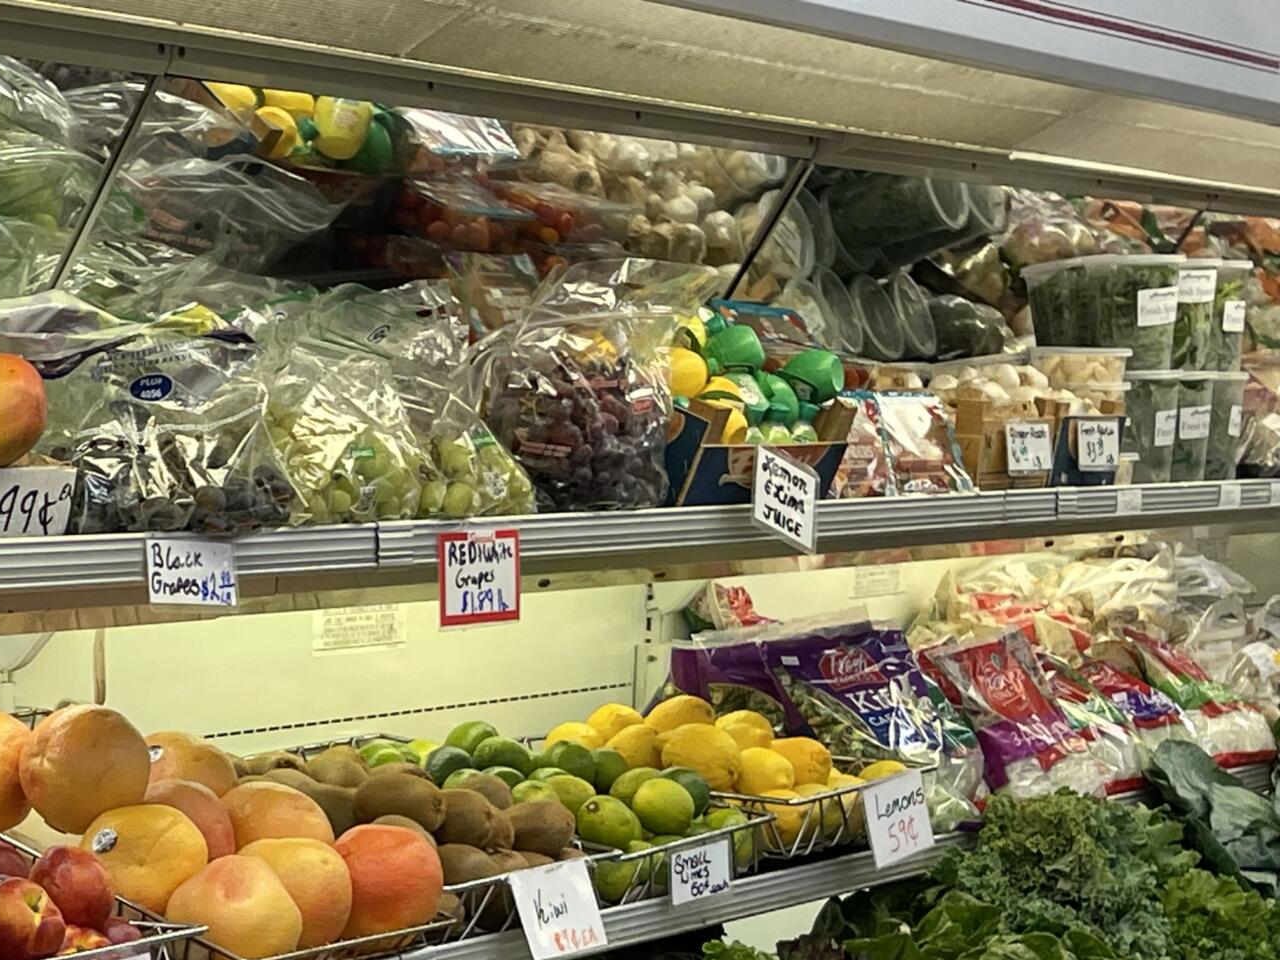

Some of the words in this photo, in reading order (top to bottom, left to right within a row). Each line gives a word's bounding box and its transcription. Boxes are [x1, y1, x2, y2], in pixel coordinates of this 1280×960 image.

[763, 504, 802, 537] JUICE
[151, 543, 203, 570] Black
[874, 787, 925, 821] Lemons
[533, 888, 568, 930] Kiwi
